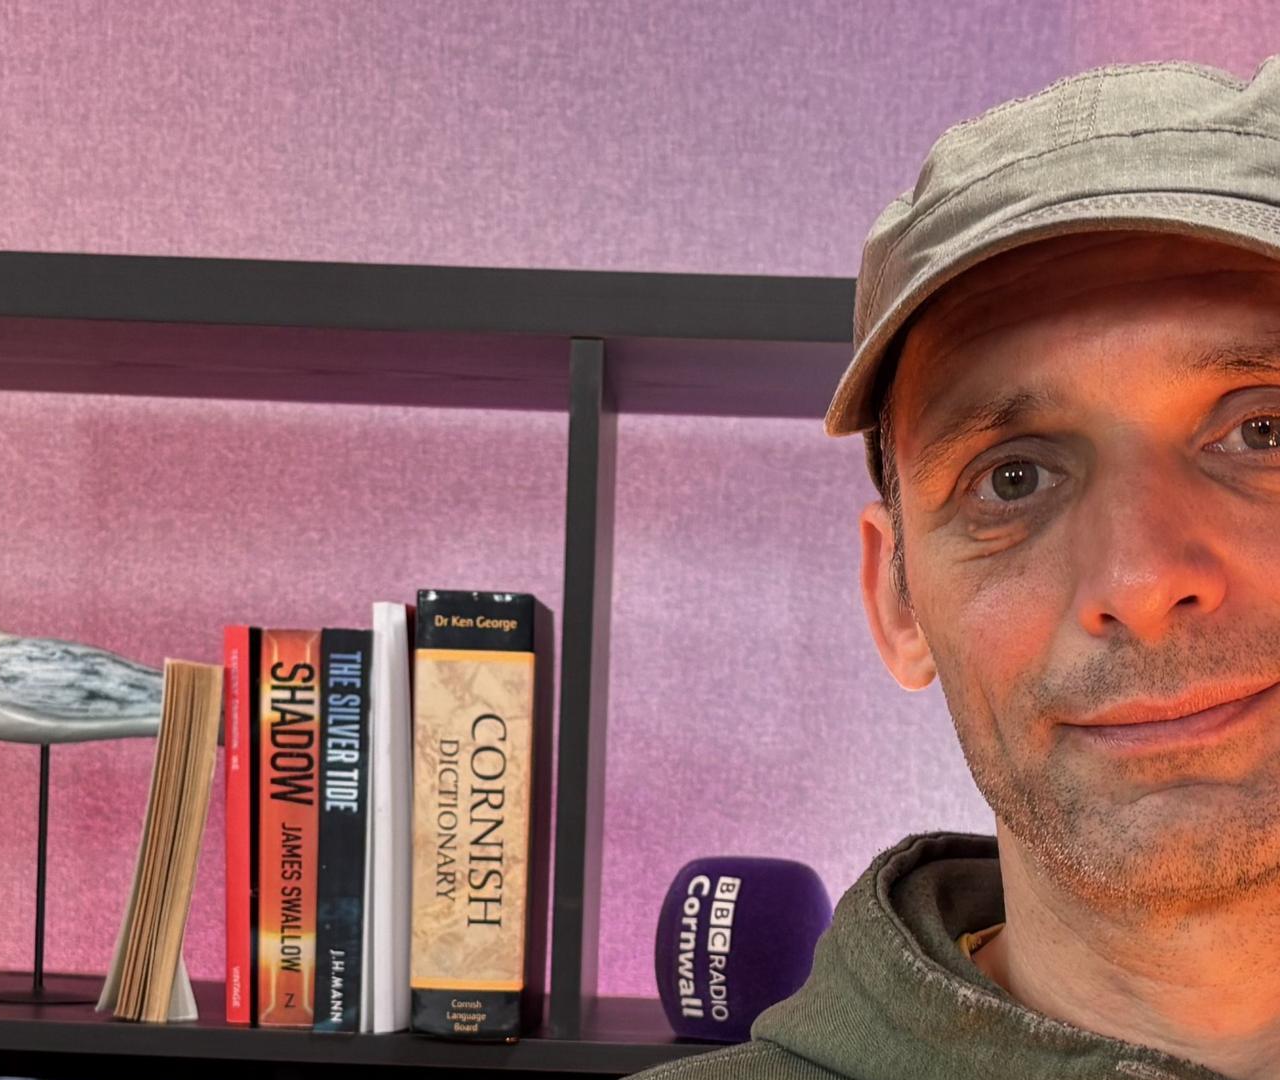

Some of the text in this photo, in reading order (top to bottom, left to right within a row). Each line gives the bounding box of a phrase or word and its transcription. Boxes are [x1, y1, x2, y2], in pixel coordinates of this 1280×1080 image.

[434, 615, 518, 632] Dr Ken George
[270, 661, 316, 806] SHADOW
[325, 651, 363, 813] THE SILVER TIDE
[435, 738, 460, 902] DICTIONARY
[467, 713, 508, 928] CORNISH
[280, 822, 303, 974] JAMES SWALLOW
[678, 875, 711, 1018] Cornwall
[708, 876, 741, 1022] BBC RADIO
[446, 1011, 487, 1023] Language
[451, 998, 482, 1009] Cornish
[453, 1022, 479, 1033] Board
